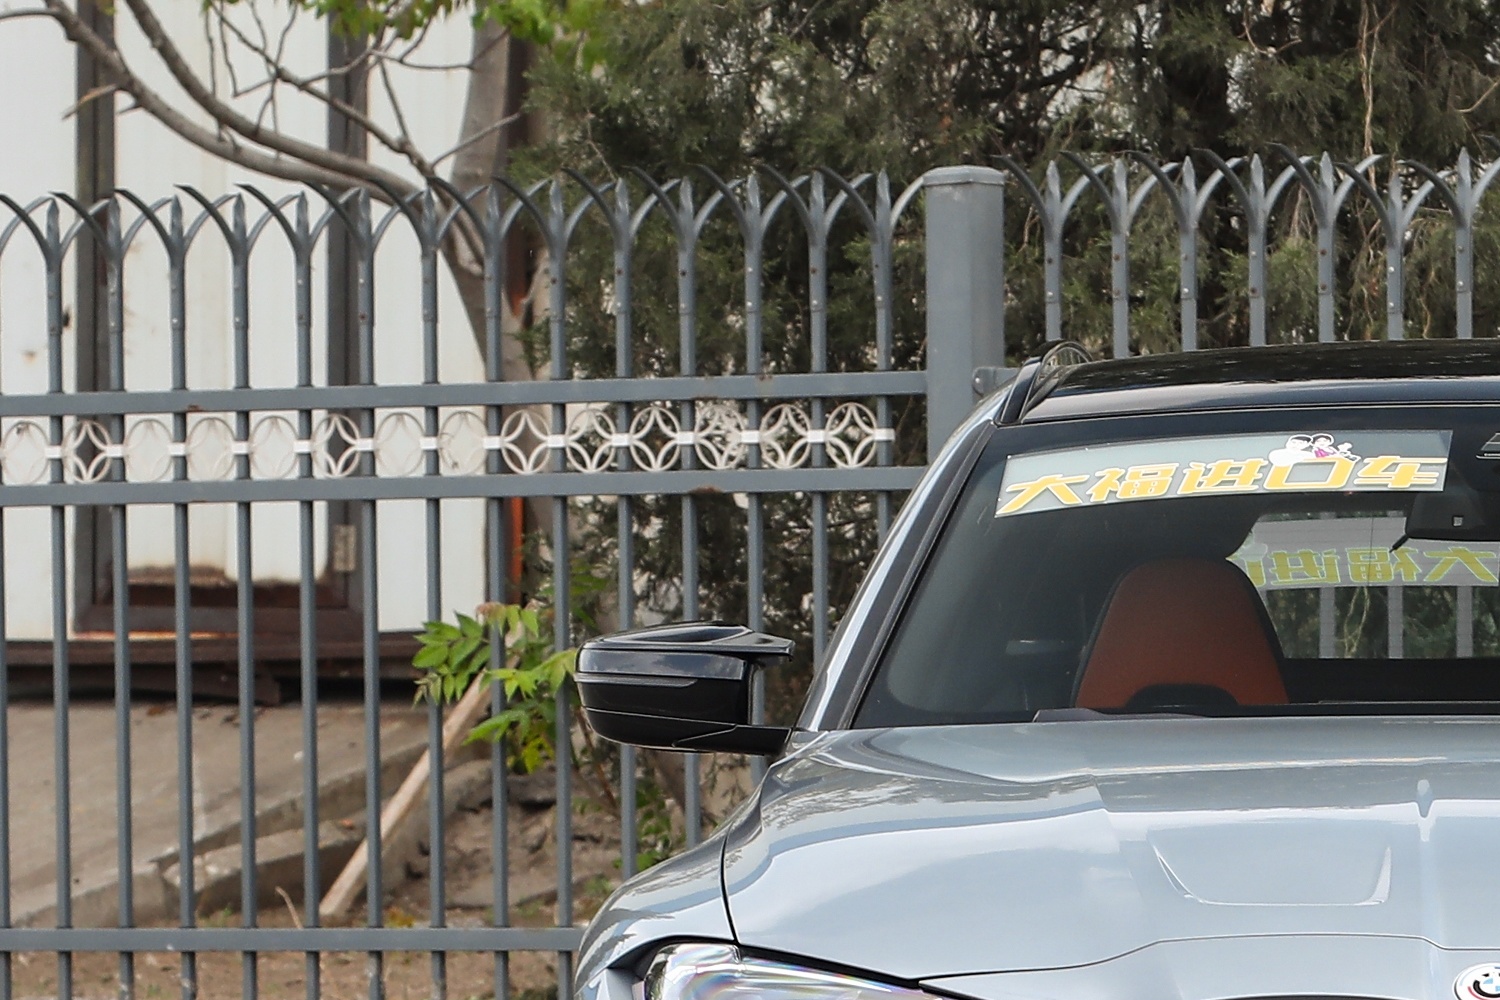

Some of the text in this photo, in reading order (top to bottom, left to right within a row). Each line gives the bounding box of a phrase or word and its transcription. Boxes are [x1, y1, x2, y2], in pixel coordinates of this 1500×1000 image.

[995, 455, 1449, 514] 大福进口车
